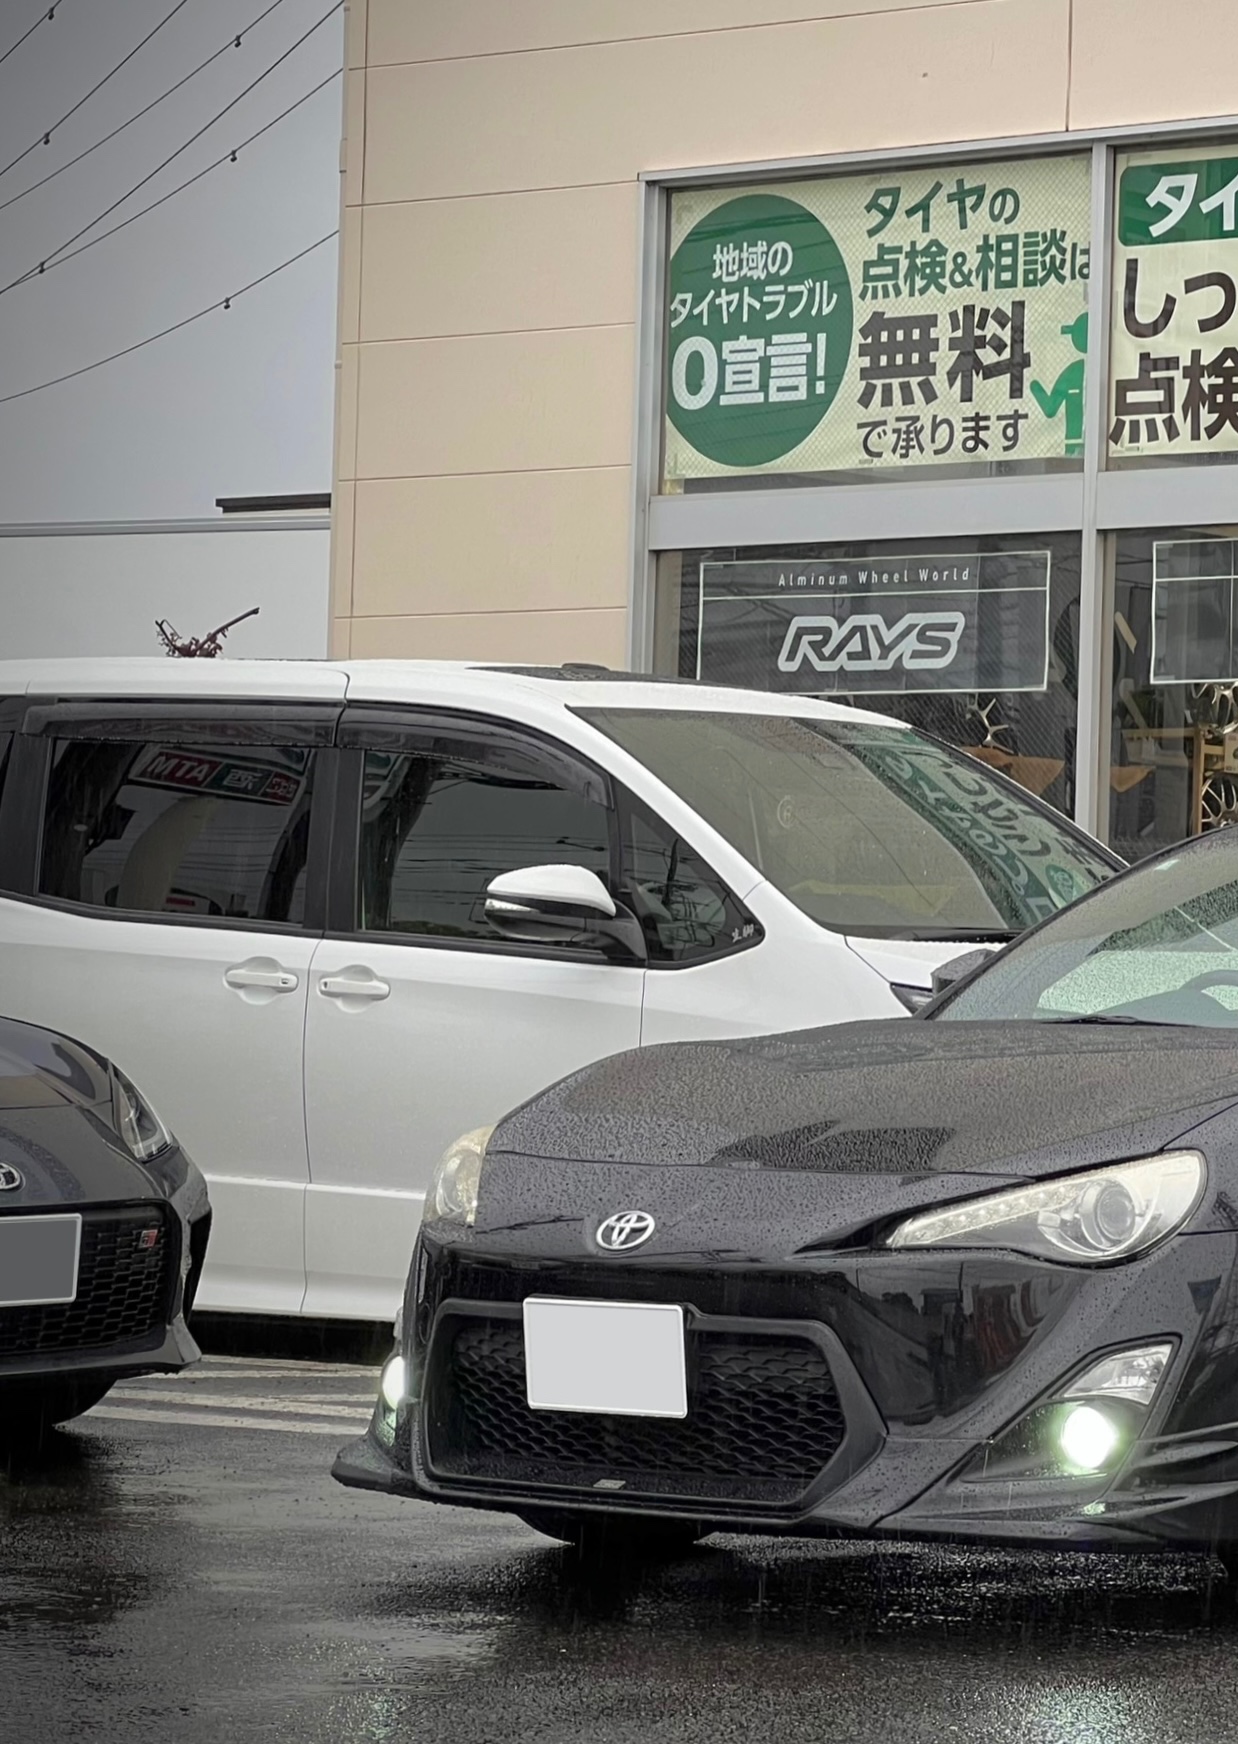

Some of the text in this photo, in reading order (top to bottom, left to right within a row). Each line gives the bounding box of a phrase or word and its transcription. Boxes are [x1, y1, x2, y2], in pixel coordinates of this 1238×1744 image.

[864, 178, 1020, 238] タイヤの
[712, 241, 793, 283] 地域の
[859, 227, 1090, 301] 点検&相談は
[669, 278, 837, 329] タイヤトラブル
[857, 300, 1031, 410] 無料
[857, 409, 1029, 459] で承ります
[778, 567, 969, 587] Alminum Wheel World
[777, 611, 965, 672] RAYS
